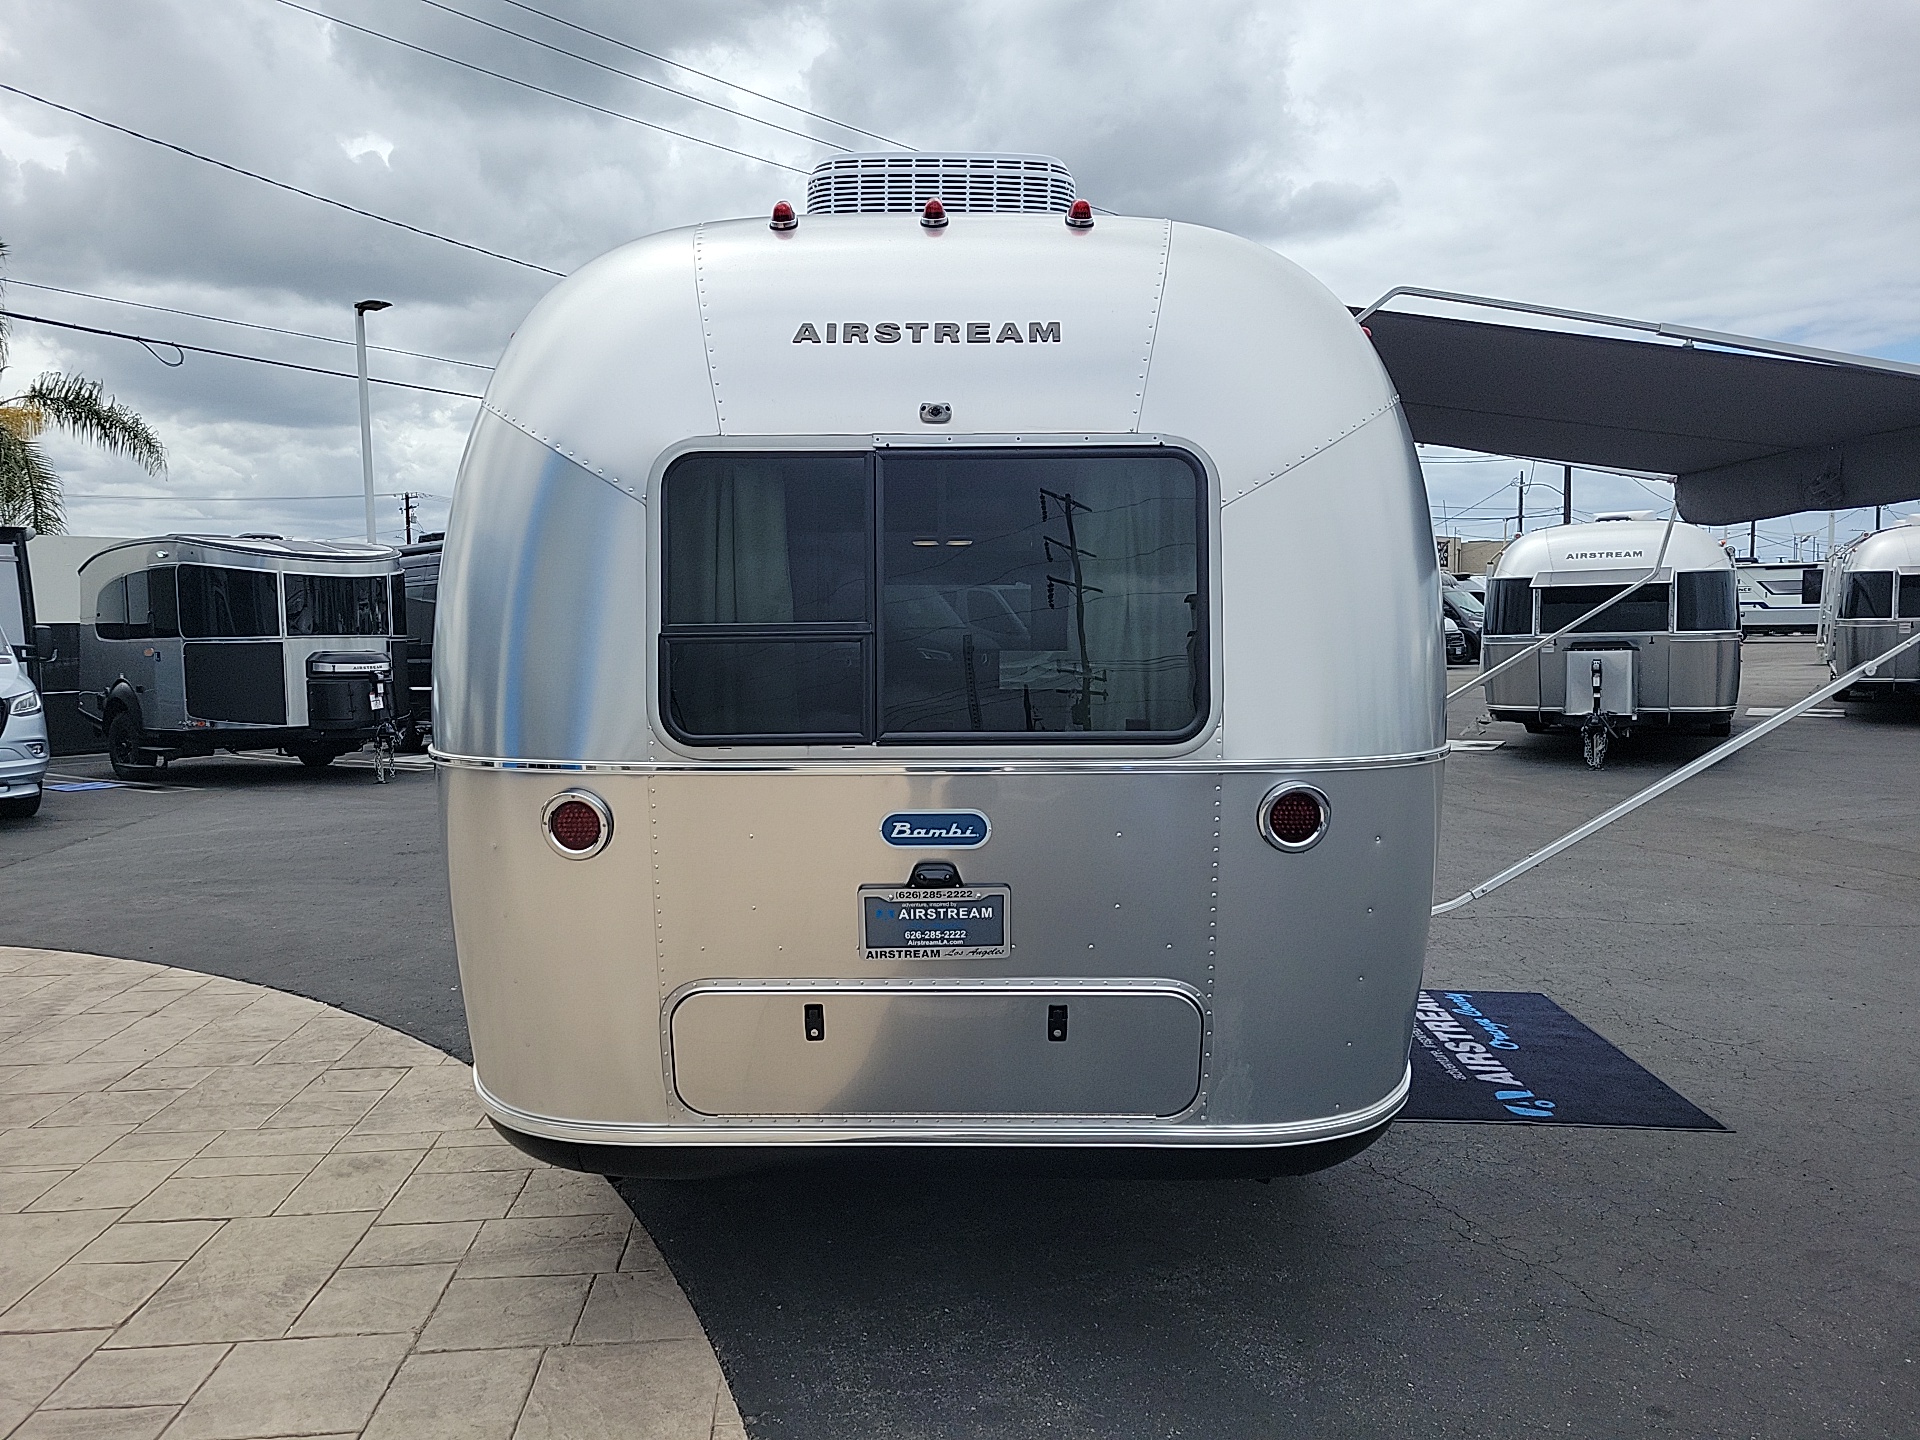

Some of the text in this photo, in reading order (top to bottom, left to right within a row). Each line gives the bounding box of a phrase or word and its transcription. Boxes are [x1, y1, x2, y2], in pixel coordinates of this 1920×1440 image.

[792, 321, 1062, 344] AIRSTREAM
[1565, 550, 1643, 560] AIRSTREAM
[890, 822, 976, 838] Bambi
[895, 890, 973, 900] (626) 285-2222
[898, 907, 993, 919] AIRSTREAM
[904, 930, 967, 939] 626-285-2222
[866, 947, 1005, 960] AIRSTREAM Los Angeles
[1443, 992, 1520, 1050] Orange County
